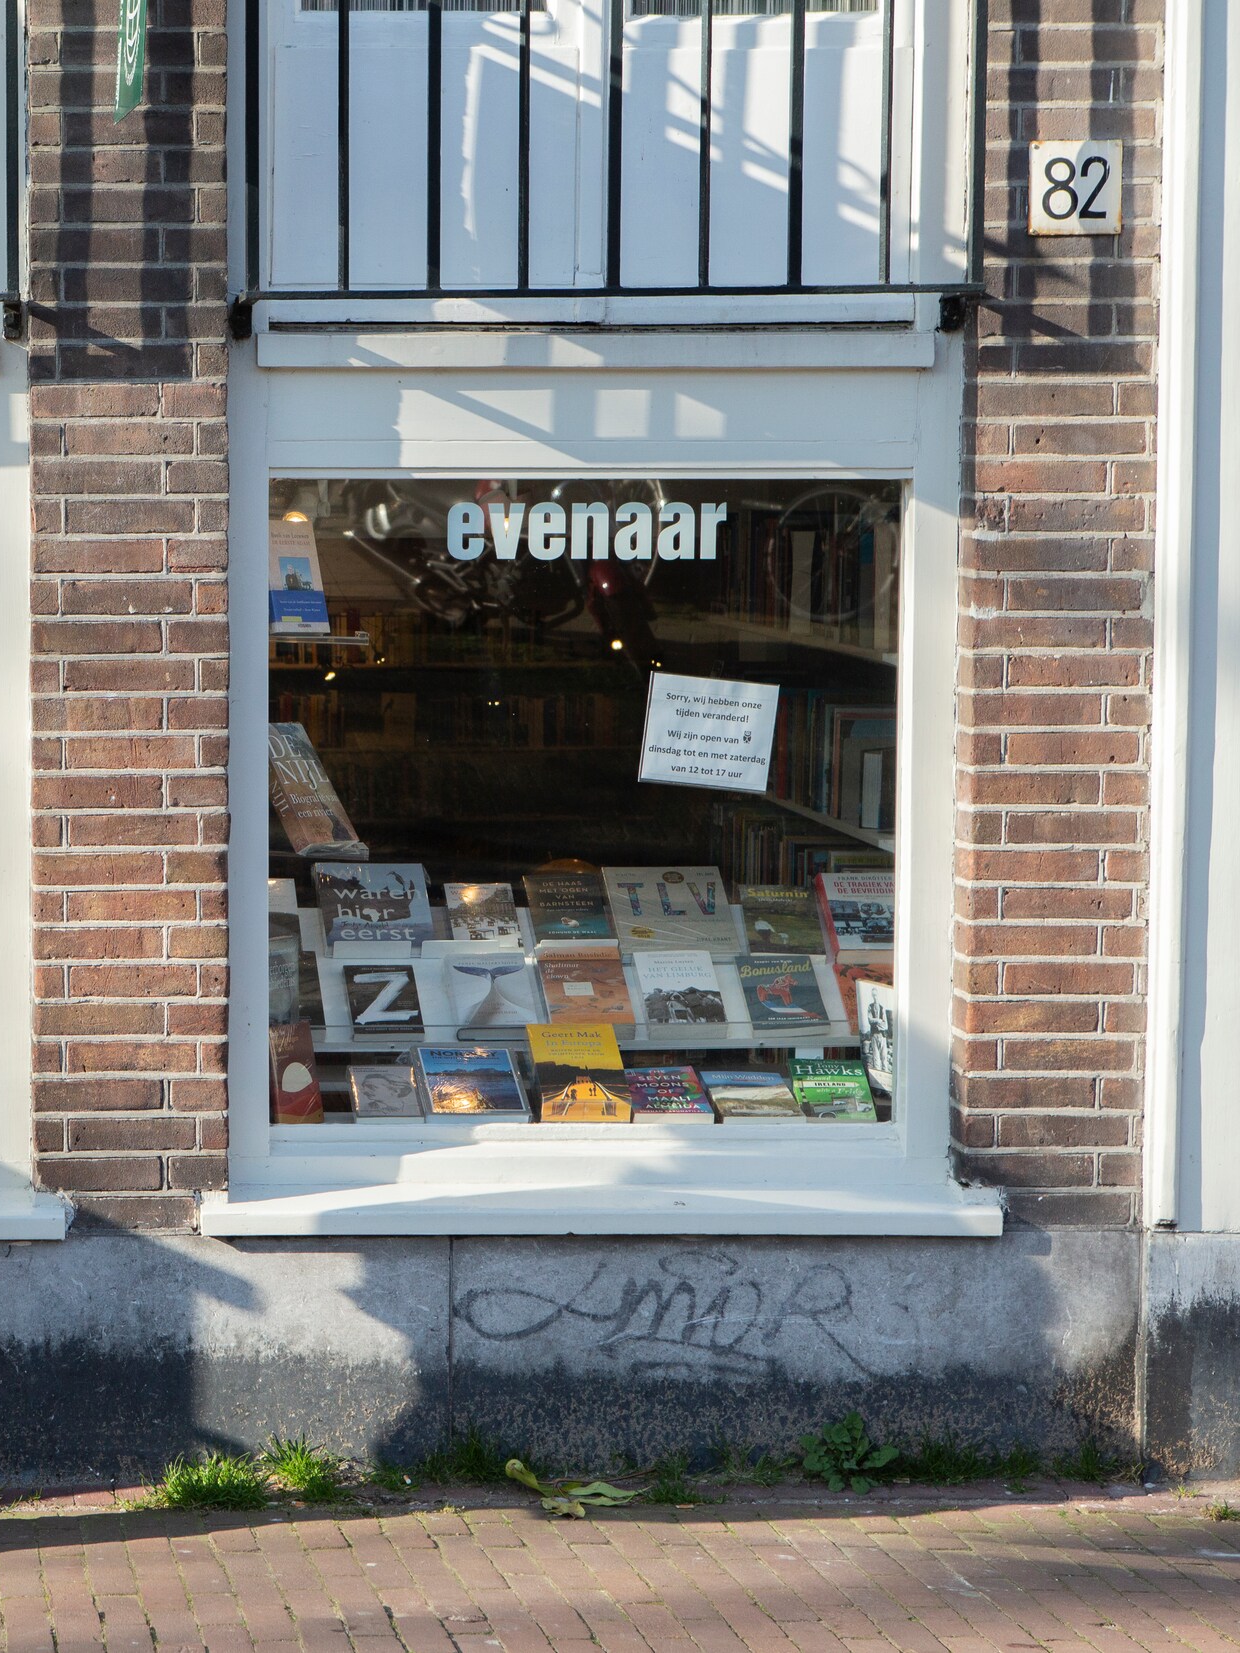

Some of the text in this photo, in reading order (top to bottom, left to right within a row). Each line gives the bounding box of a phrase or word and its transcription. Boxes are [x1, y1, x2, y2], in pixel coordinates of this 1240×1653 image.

[1042, 155, 1111, 220] 82
[446, 501, 727, 561] evenaar
[666, 692, 691, 703] Sorry,
[693, 696, 706, 705] wij
[708, 697, 740, 707] hebben
[676, 708, 749, 723] tijden veranderd!
[667, 729, 682, 739] Wij
[683, 731, 698, 741] zijn
[700, 735, 722, 743] open
[268, 734, 301, 759] DE
[648, 744, 682, 757] dinsdag
[683, 749, 696, 757] tot
[710, 752, 728, 760] met
[729, 754, 766, 766] zaterdag
[274, 760, 329, 790] NIJL
[688, 766, 699, 774] 12
[701, 767, 714, 776] tot
[716, 769, 726, 777] 17
[727, 771, 743, 779] uur
[297, 810, 312, 818] een
[333, 888, 420, 900] waren
[616, 882, 716, 917] TLV
[747, 888, 808, 898] Saturnin
[340, 927, 416, 940] eerst
[740, 960, 812, 977] Bonusland
[353, 971, 419, 1025] Z
[794, 1065, 863, 1076] Hawks
